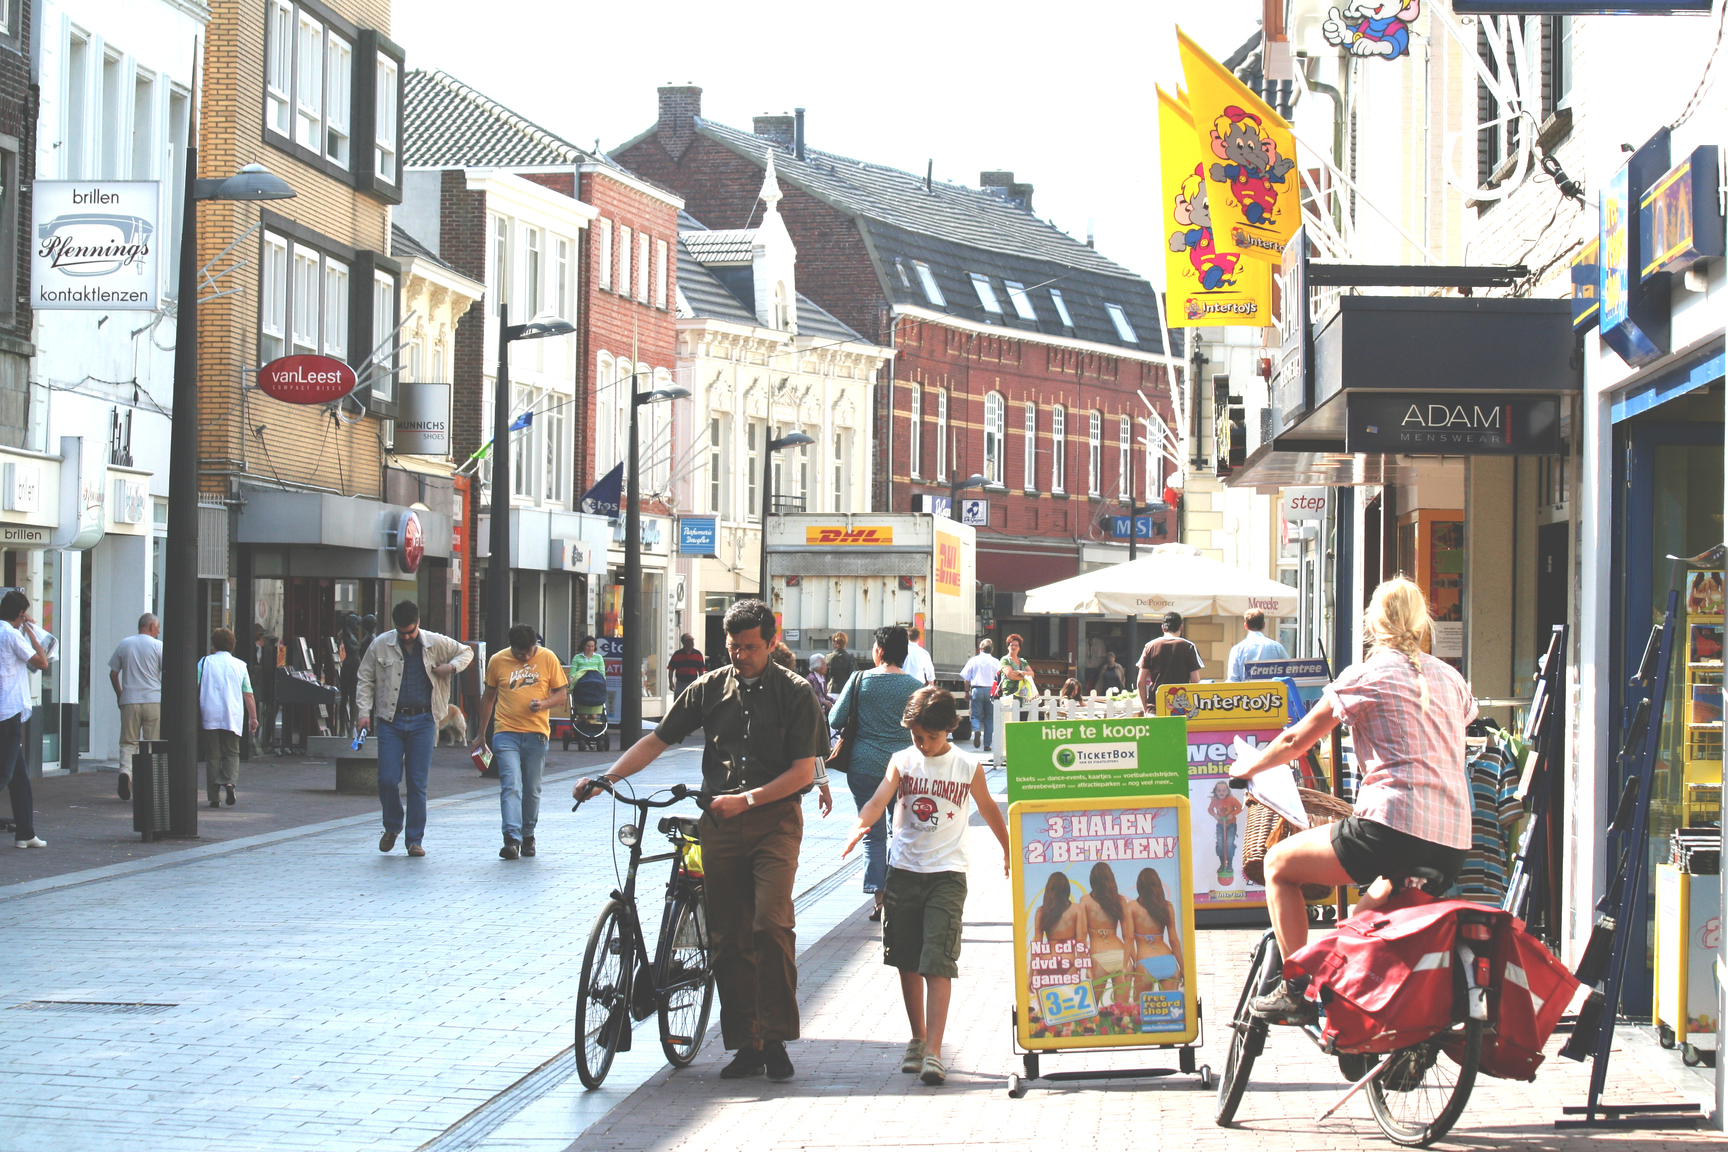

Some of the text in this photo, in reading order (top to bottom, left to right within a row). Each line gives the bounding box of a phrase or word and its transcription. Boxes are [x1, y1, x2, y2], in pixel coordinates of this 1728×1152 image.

[72, 188, 120, 204] brillen
[38, 235, 149, 268] Pfennings
[40, 284, 148, 302] kontaktlenzen
[1202, 301, 1258, 315] Intertoys
[271, 366, 342, 384] vanLeest
[1401, 404, 1500, 428] ADAM
[396, 421, 445, 430] MUNNICHS
[1400, 433, 1500, 443] MENSWEAR
[1290, 495, 1326, 513] step
[4, 528, 42, 540] brillen
[818, 529, 881, 543] DHL
[1250, 664, 1323, 676] Gratis entree
[1192, 691, 1283, 713] Intertoys
[1042, 723, 1150, 740] hier te koop:
[1048, 813, 1154, 839] 3 HALEN
[1027, 836, 1176, 864] 2 BETALEN!
[1031, 940, 1089, 954] Nu cd's,
[1031, 956, 1092, 970] dvd's en
[1032, 972, 1080, 989] games
[1045, 985, 1092, 1017] 3=2
[1142, 994, 1166, 1002] free
[1144, 1000, 1181, 1008] record
[1143, 1007, 1169, 1016] shop
